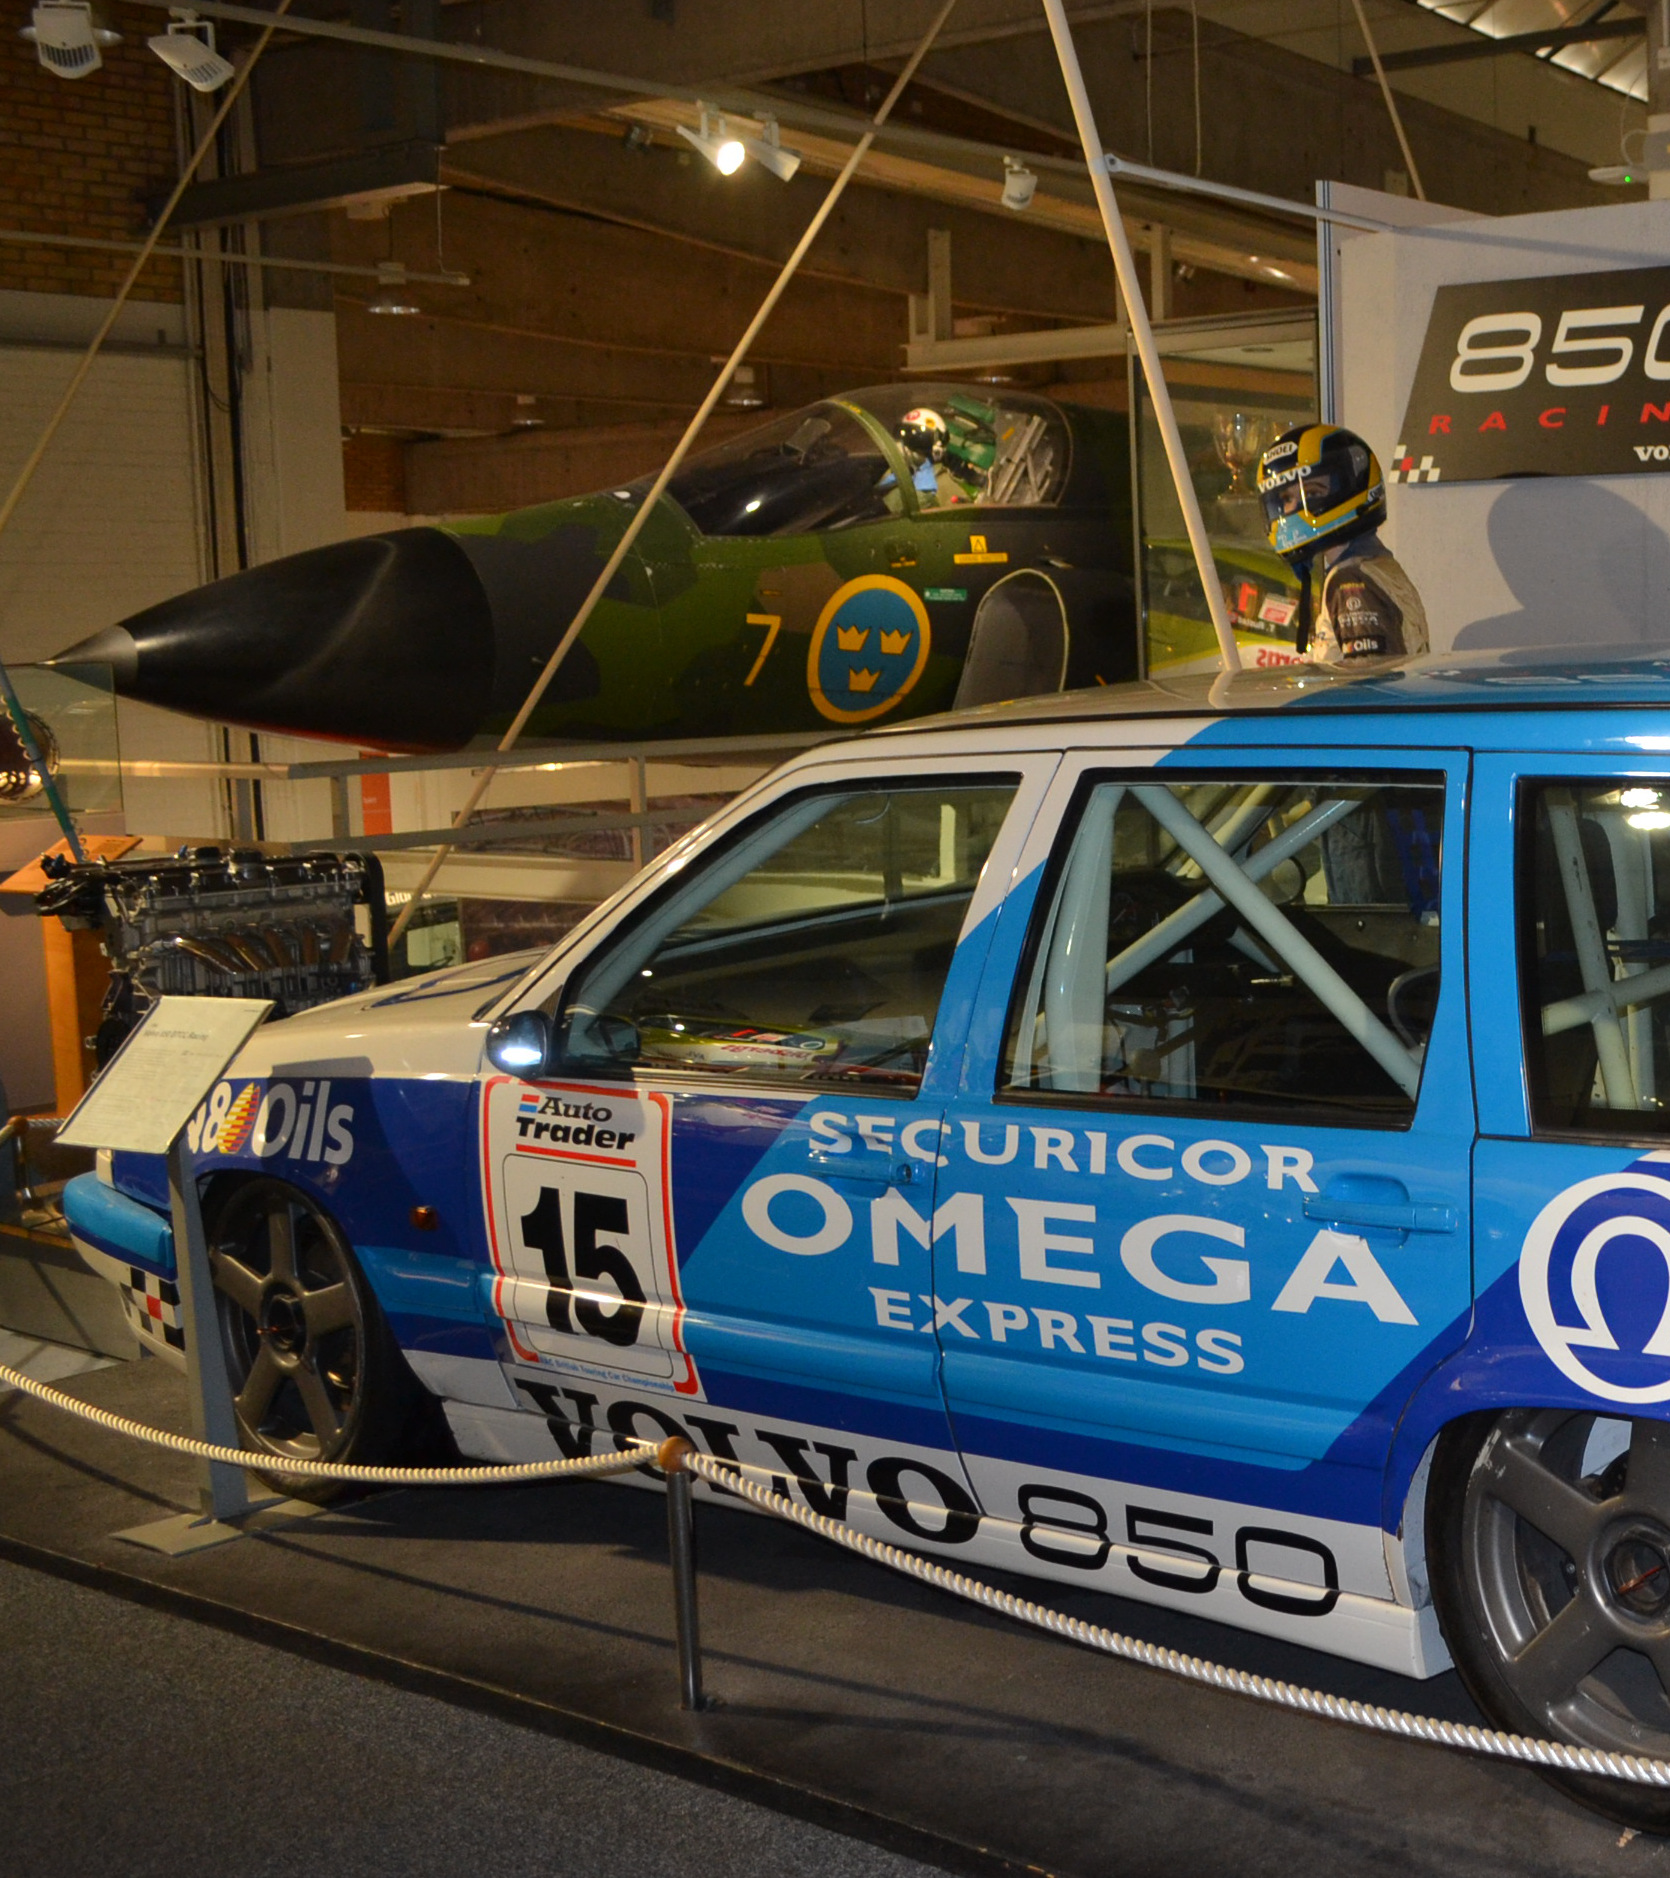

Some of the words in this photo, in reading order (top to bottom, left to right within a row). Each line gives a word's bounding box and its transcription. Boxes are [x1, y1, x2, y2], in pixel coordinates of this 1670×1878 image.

[1258, 465, 1312, 494] VOLVO
[745, 613, 781, 687] 7
[1353, 638, 1379, 652] Oils
[252, 1080, 355, 1166] Oils
[516, 1116, 635, 1150] Trader
[537, 1096, 613, 1122] Auto
[808, 1111, 1320, 1193] SECURICOR
[521, 1186, 648, 1347] 15
[741, 1172, 1420, 1327] OMEGA
[868, 1285, 1246, 1375] EXPRESS
[554, 1358, 580, 1371] British
[580, 1364, 608, 1379] Touring
[608, 1370, 621, 1380] Car
[621, 1373, 676, 1393] Championship
[517, 1378, 980, 1545] VOLVO
[1017, 1484, 1340, 1617] 850
